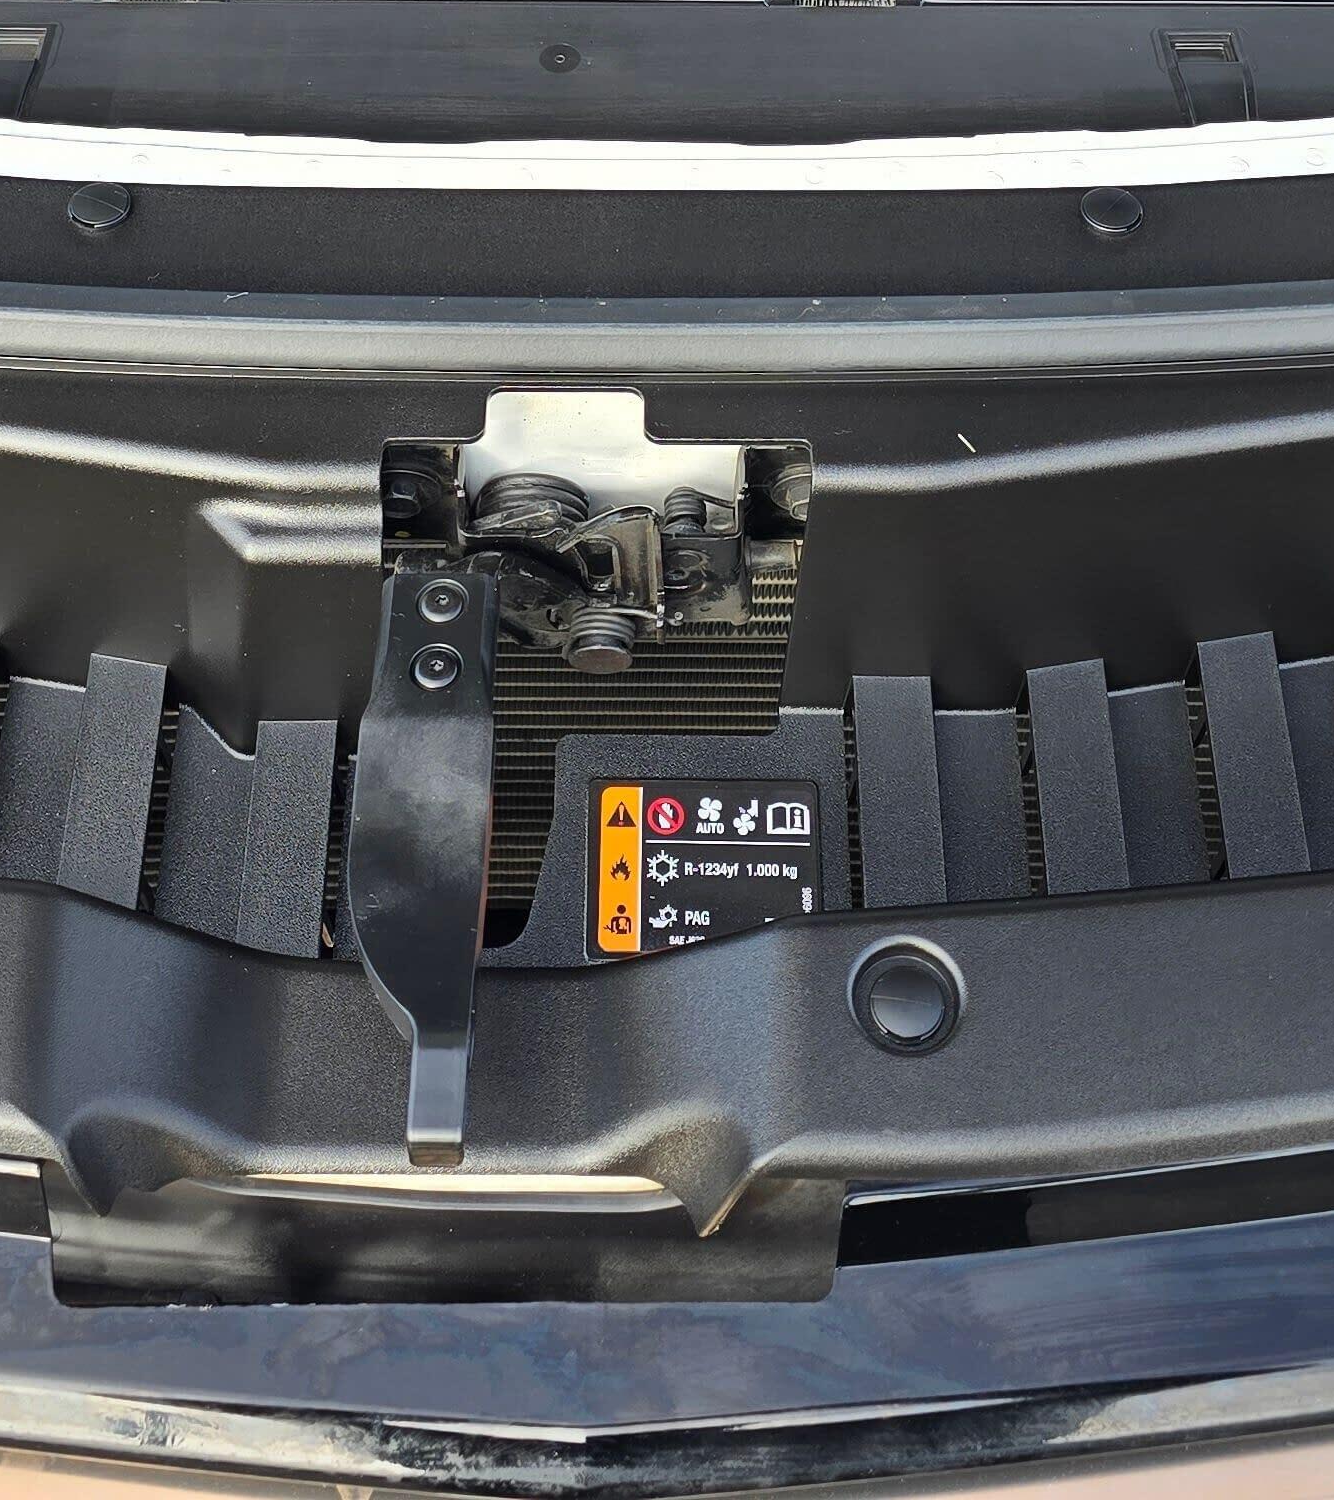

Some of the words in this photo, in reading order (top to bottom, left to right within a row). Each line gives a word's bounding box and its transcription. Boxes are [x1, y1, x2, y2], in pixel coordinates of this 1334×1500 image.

[696, 822, 725, 835] AUTO
[684, 861, 739, 879] R-1234yf
[746, 863, 779, 877] 1.000
[782, 863, 798, 880] kg
[684, 910, 710, 926] PAG
[668, 935, 685, 945] SAE
